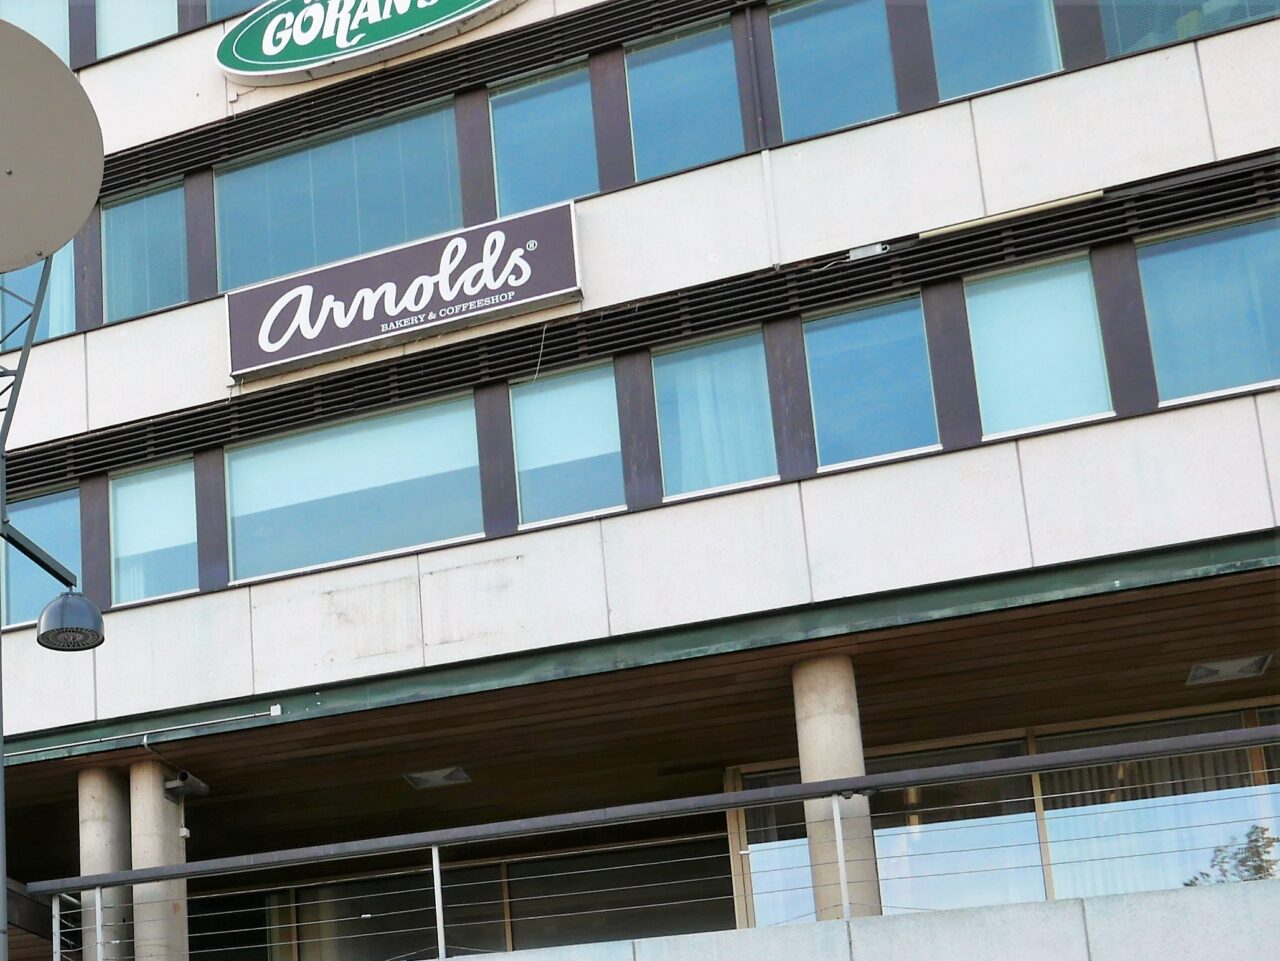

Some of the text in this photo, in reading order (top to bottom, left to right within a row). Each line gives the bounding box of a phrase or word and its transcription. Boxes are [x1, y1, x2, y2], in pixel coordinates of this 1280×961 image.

[381, 291, 516, 332] BAKERY & COFFEESHOP
